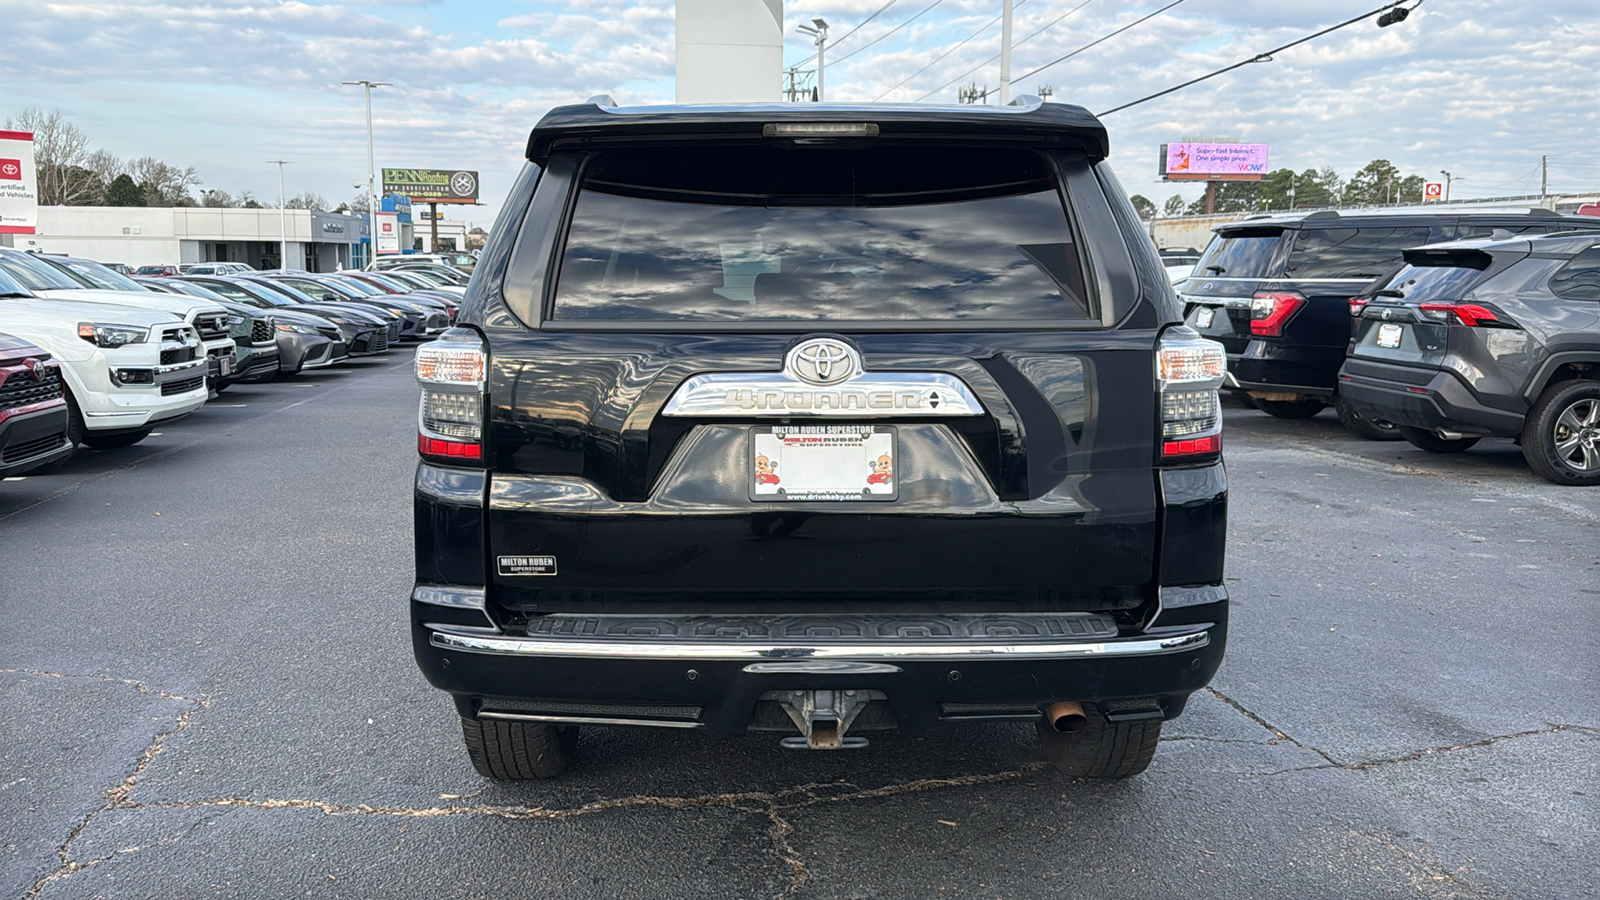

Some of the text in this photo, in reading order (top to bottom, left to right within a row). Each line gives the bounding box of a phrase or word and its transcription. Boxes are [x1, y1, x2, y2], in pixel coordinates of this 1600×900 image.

[1210, 155, 1229, 163] simple
[384, 169, 423, 182] PENN
[423, 172, 449, 185] Roofing
[6, 191, 34, 199] Vehicles
[724, 389, 922, 409] 4RUNNER
[772, 425, 875, 434] MILTON RUBEN SUPERSTORE
[501, 557, 553, 566] MILTON RUBEN
